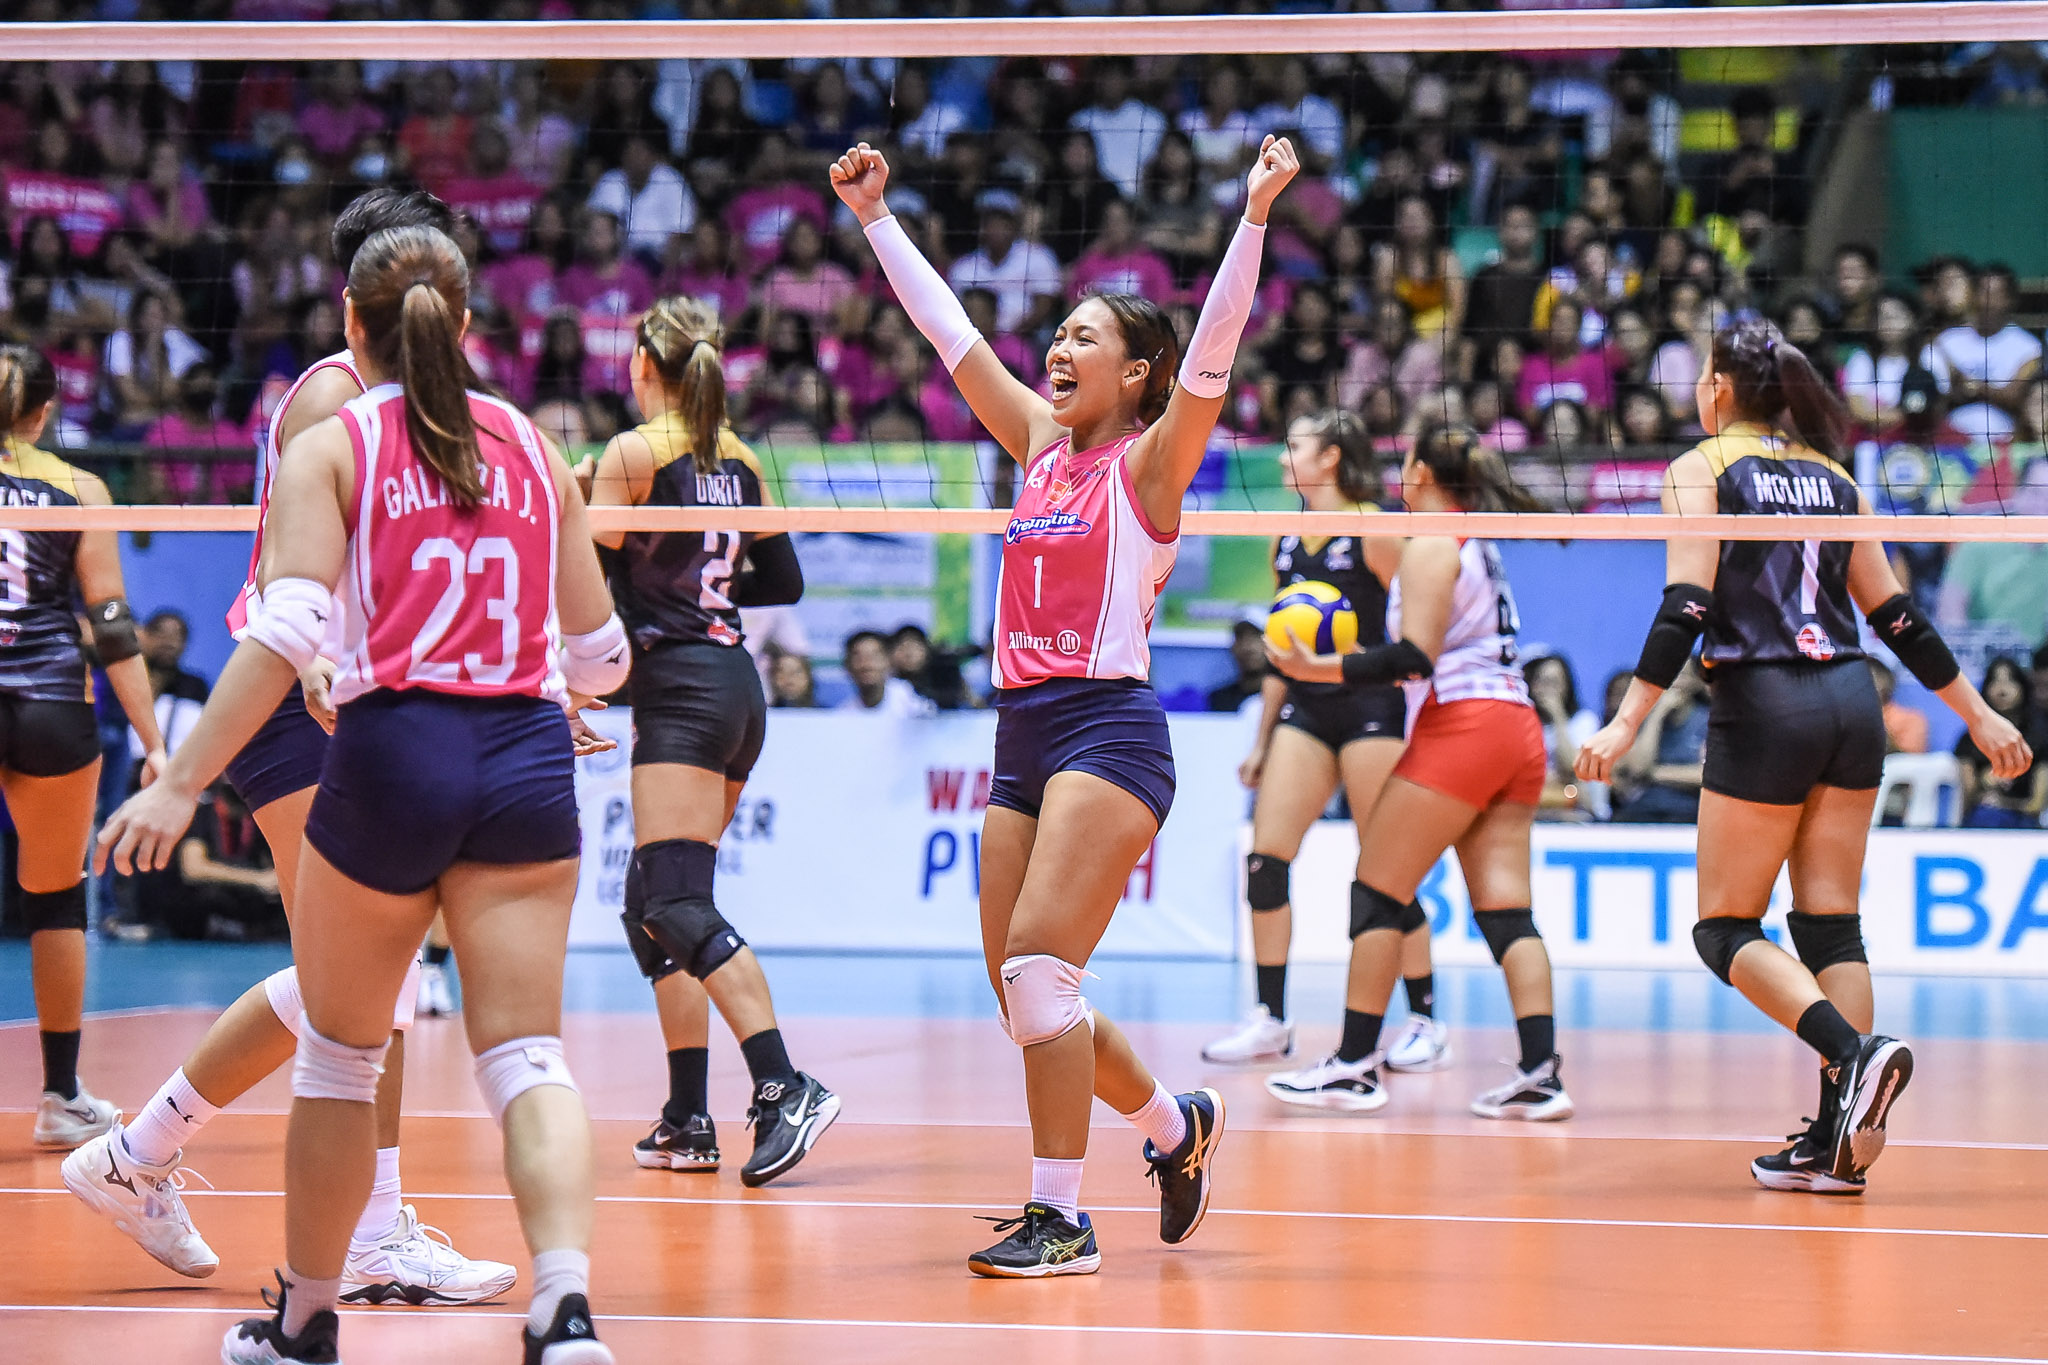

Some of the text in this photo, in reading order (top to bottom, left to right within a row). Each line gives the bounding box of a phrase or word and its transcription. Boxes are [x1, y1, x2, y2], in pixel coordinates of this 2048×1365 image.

[382, 463, 537, 525] GALZA J.
[1006, 508, 1080, 544] Cremine
[699, 530, 742, 610] 2
[1033, 555, 1043, 609] 1
[405, 537, 520, 685] 23
[1008, 631, 1054, 651] Allianz
